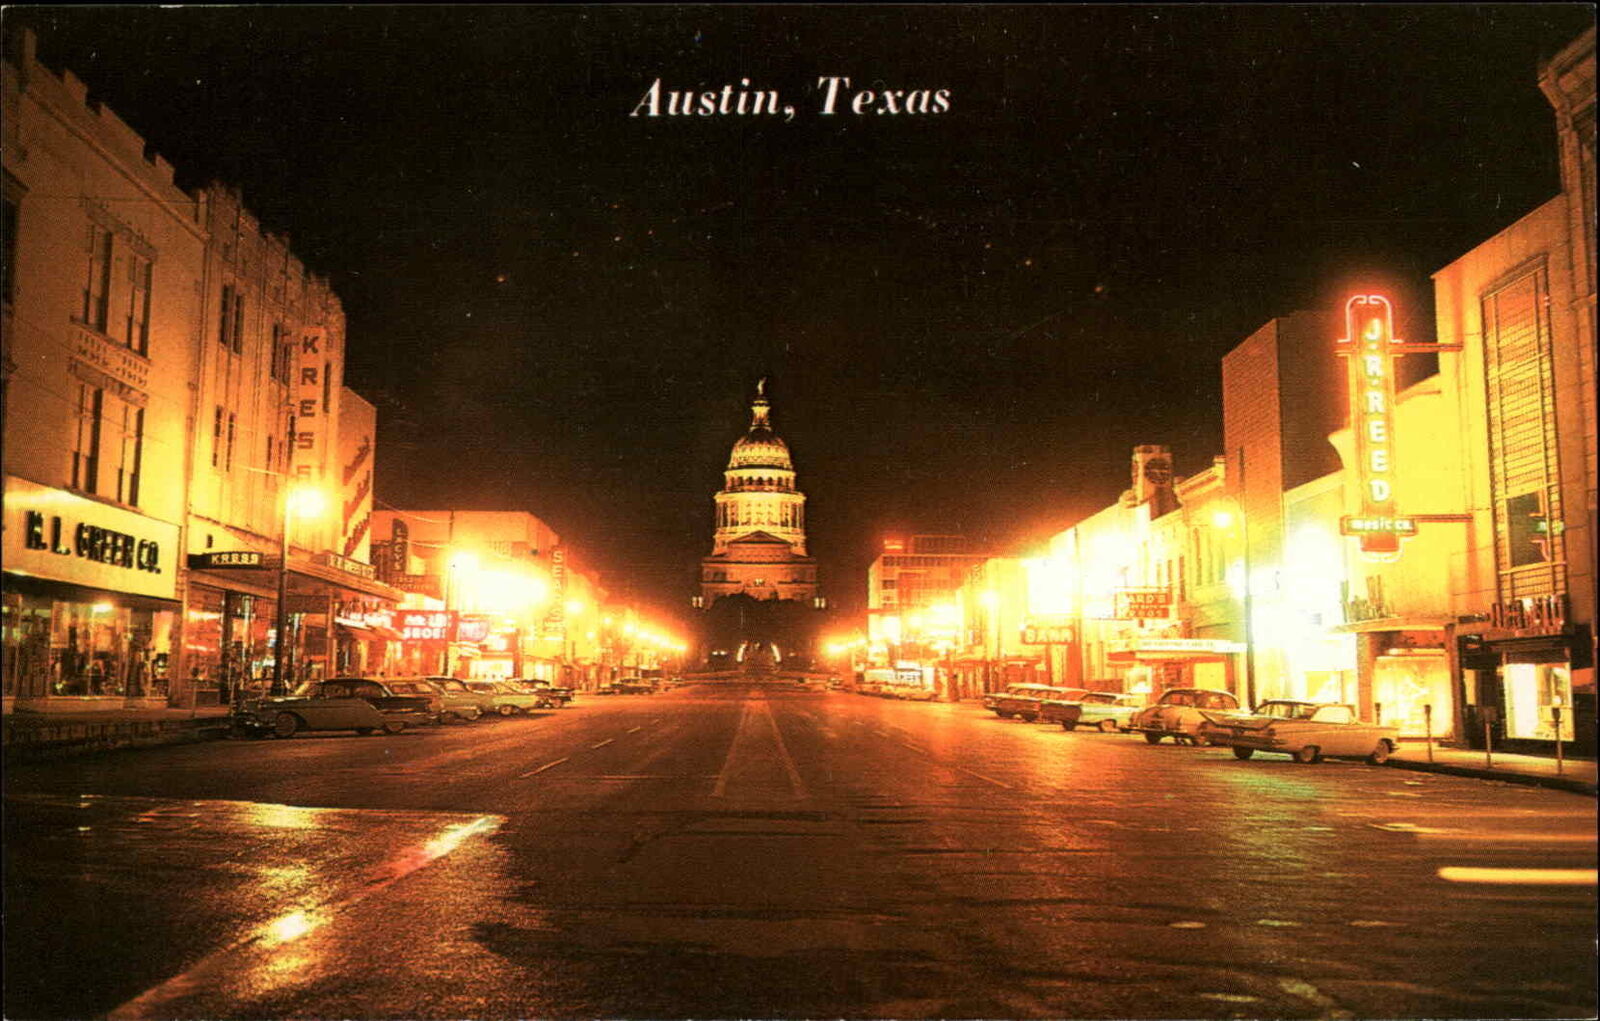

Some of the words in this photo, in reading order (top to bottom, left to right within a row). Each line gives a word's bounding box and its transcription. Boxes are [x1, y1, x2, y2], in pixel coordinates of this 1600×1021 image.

[296, 335, 320, 482] KRESS
[1351, 516, 1393, 531] music
[74, 522, 136, 569] GREEN
[1118, 593, 1167, 605] ARD'S
